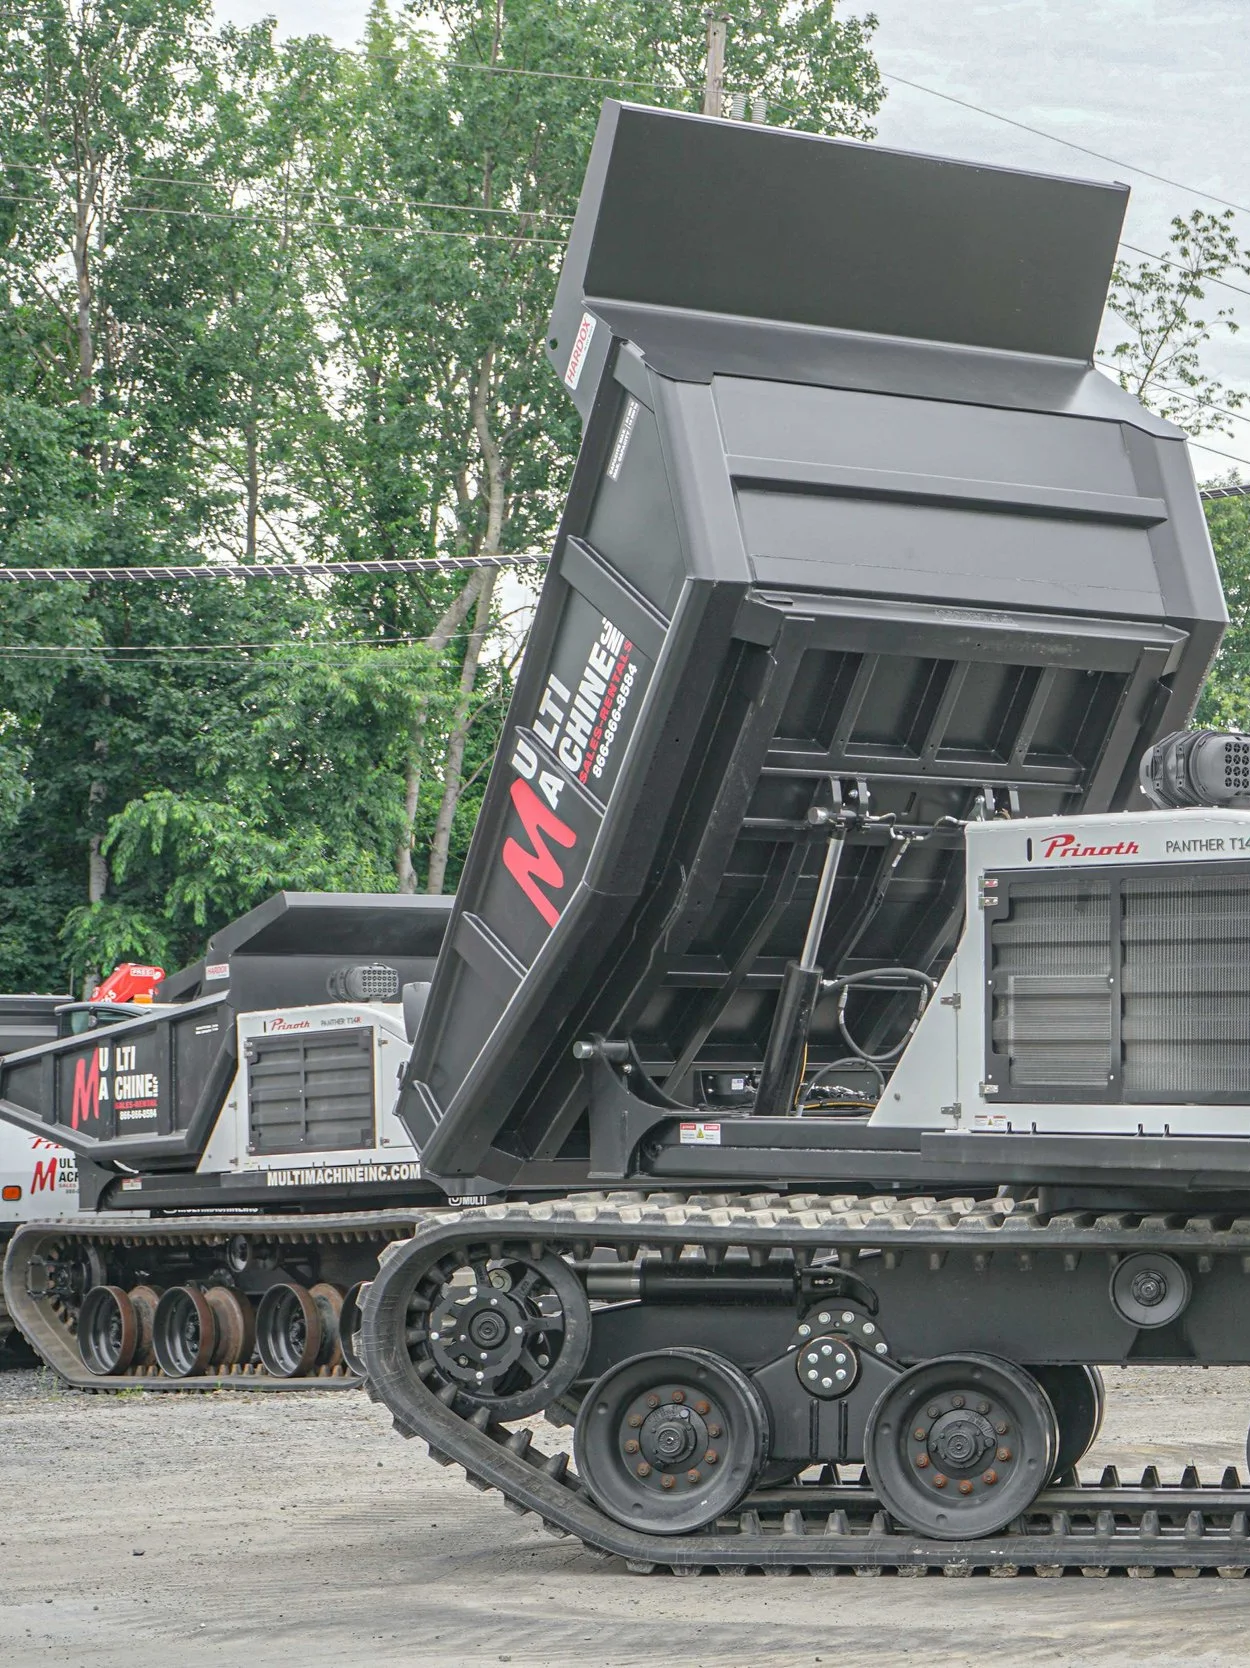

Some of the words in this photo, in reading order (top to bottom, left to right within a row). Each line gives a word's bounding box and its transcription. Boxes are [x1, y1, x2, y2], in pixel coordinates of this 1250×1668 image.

[567, 320, 591, 383] HARDOX
[578, 640, 633, 785] SALES-RENTALS
[592, 663, 639, 779] 866-866-8584
[1040, 833, 1139, 858] Prinoth
[1165, 839, 1225, 853] PANTHER
[270, 1017, 311, 1031] Prinoth
[267, 1164, 421, 1186] MULTIMACHINEINC.COM
